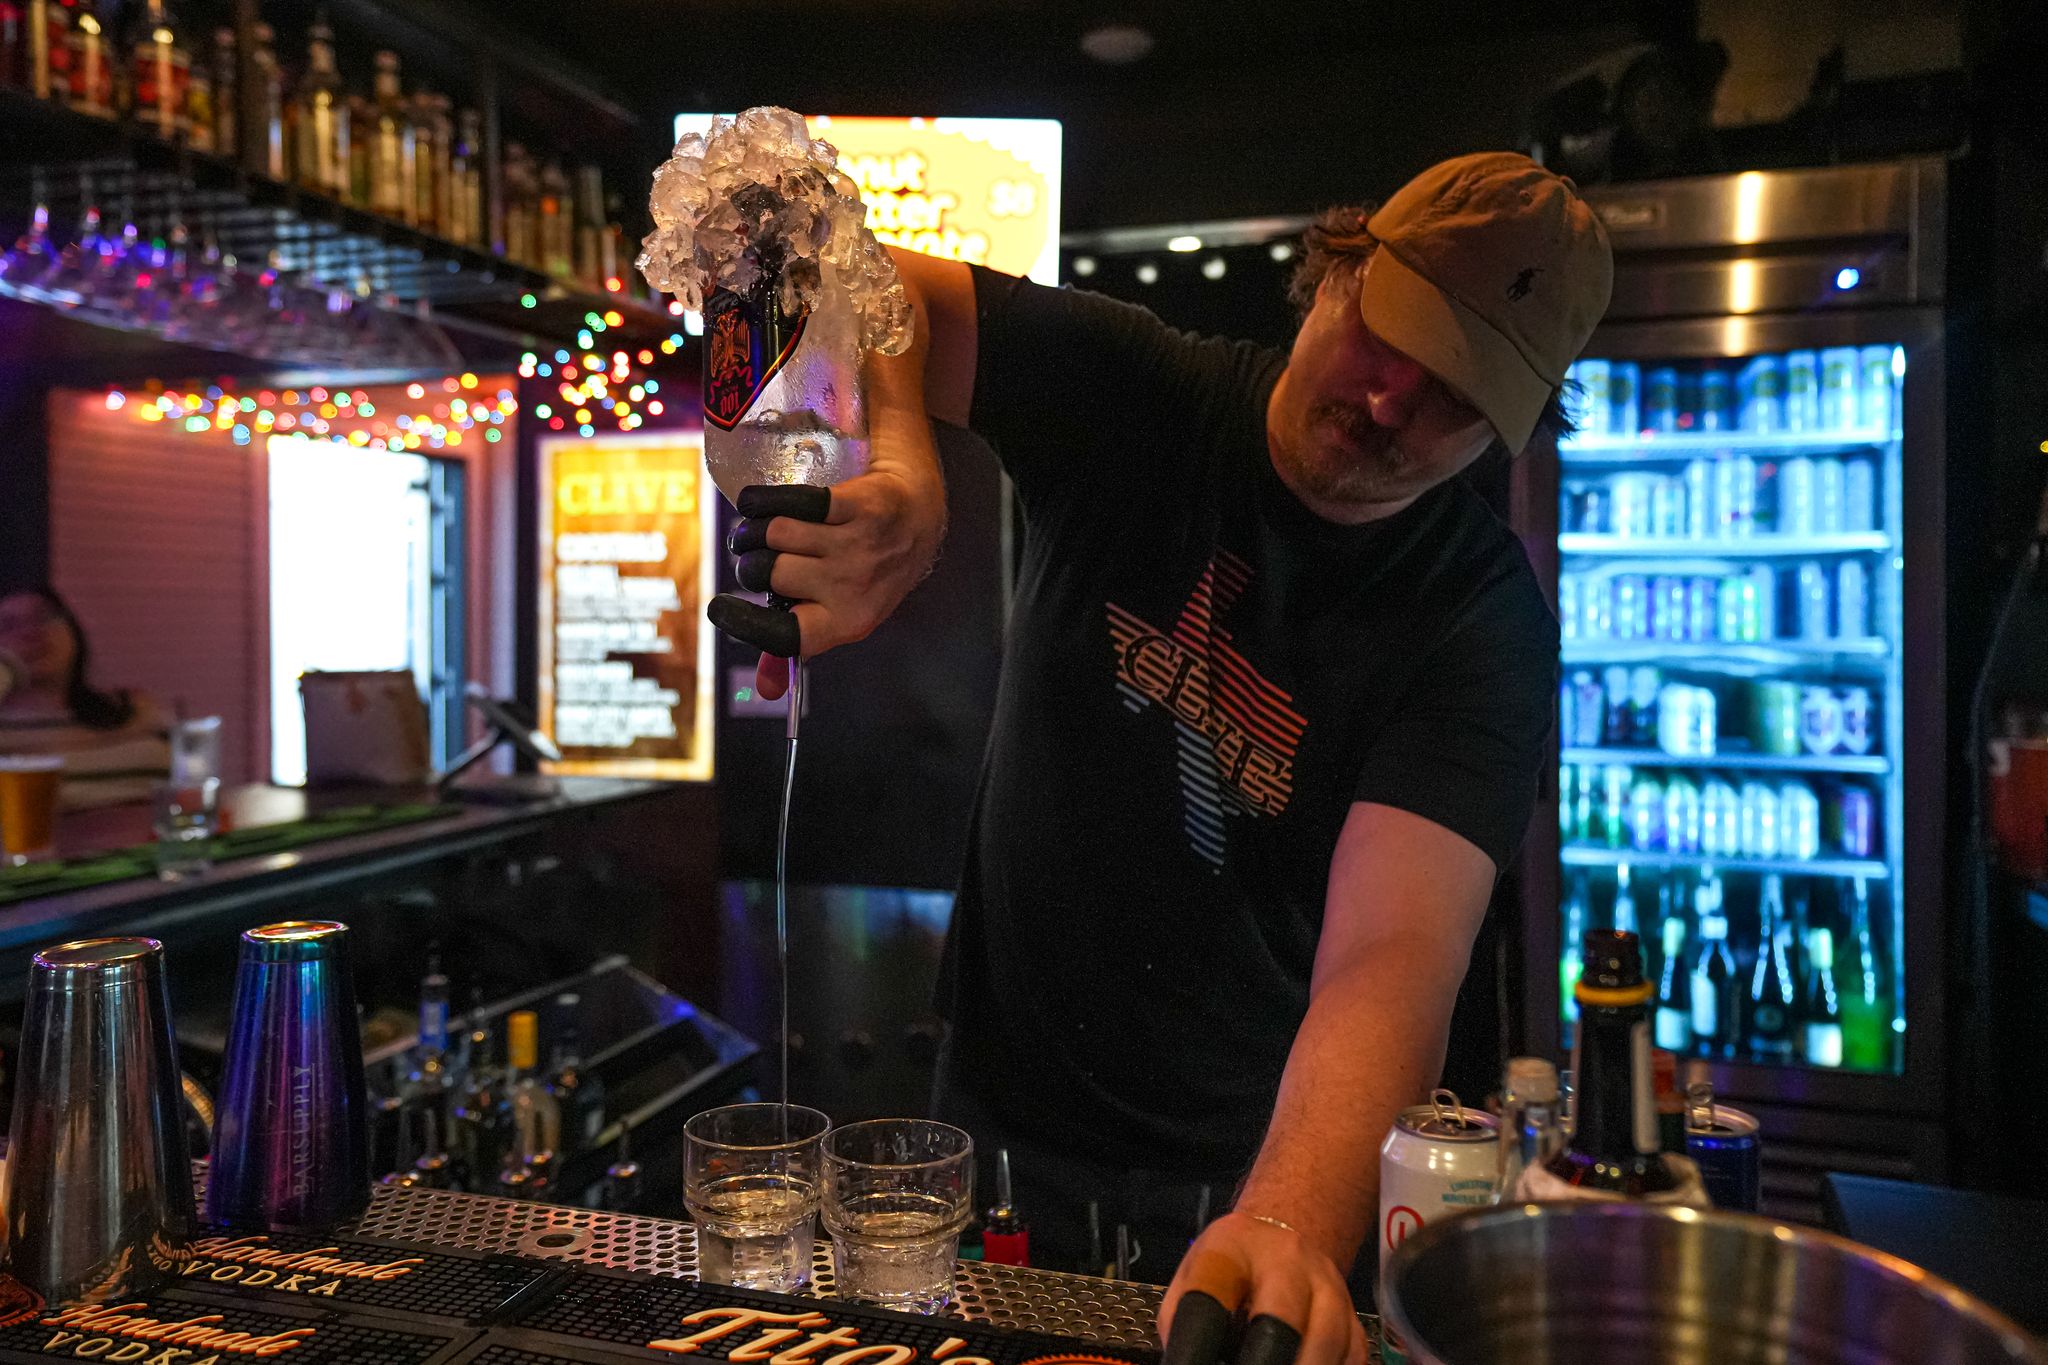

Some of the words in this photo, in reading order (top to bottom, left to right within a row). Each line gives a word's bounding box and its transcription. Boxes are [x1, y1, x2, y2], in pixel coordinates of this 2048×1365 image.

[559, 470, 696, 514] CLIVE
[182, 1261, 342, 1296] VODKA
[197, 1236, 425, 1281] Handmade
[39, 1303, 316, 1357] Handmade
